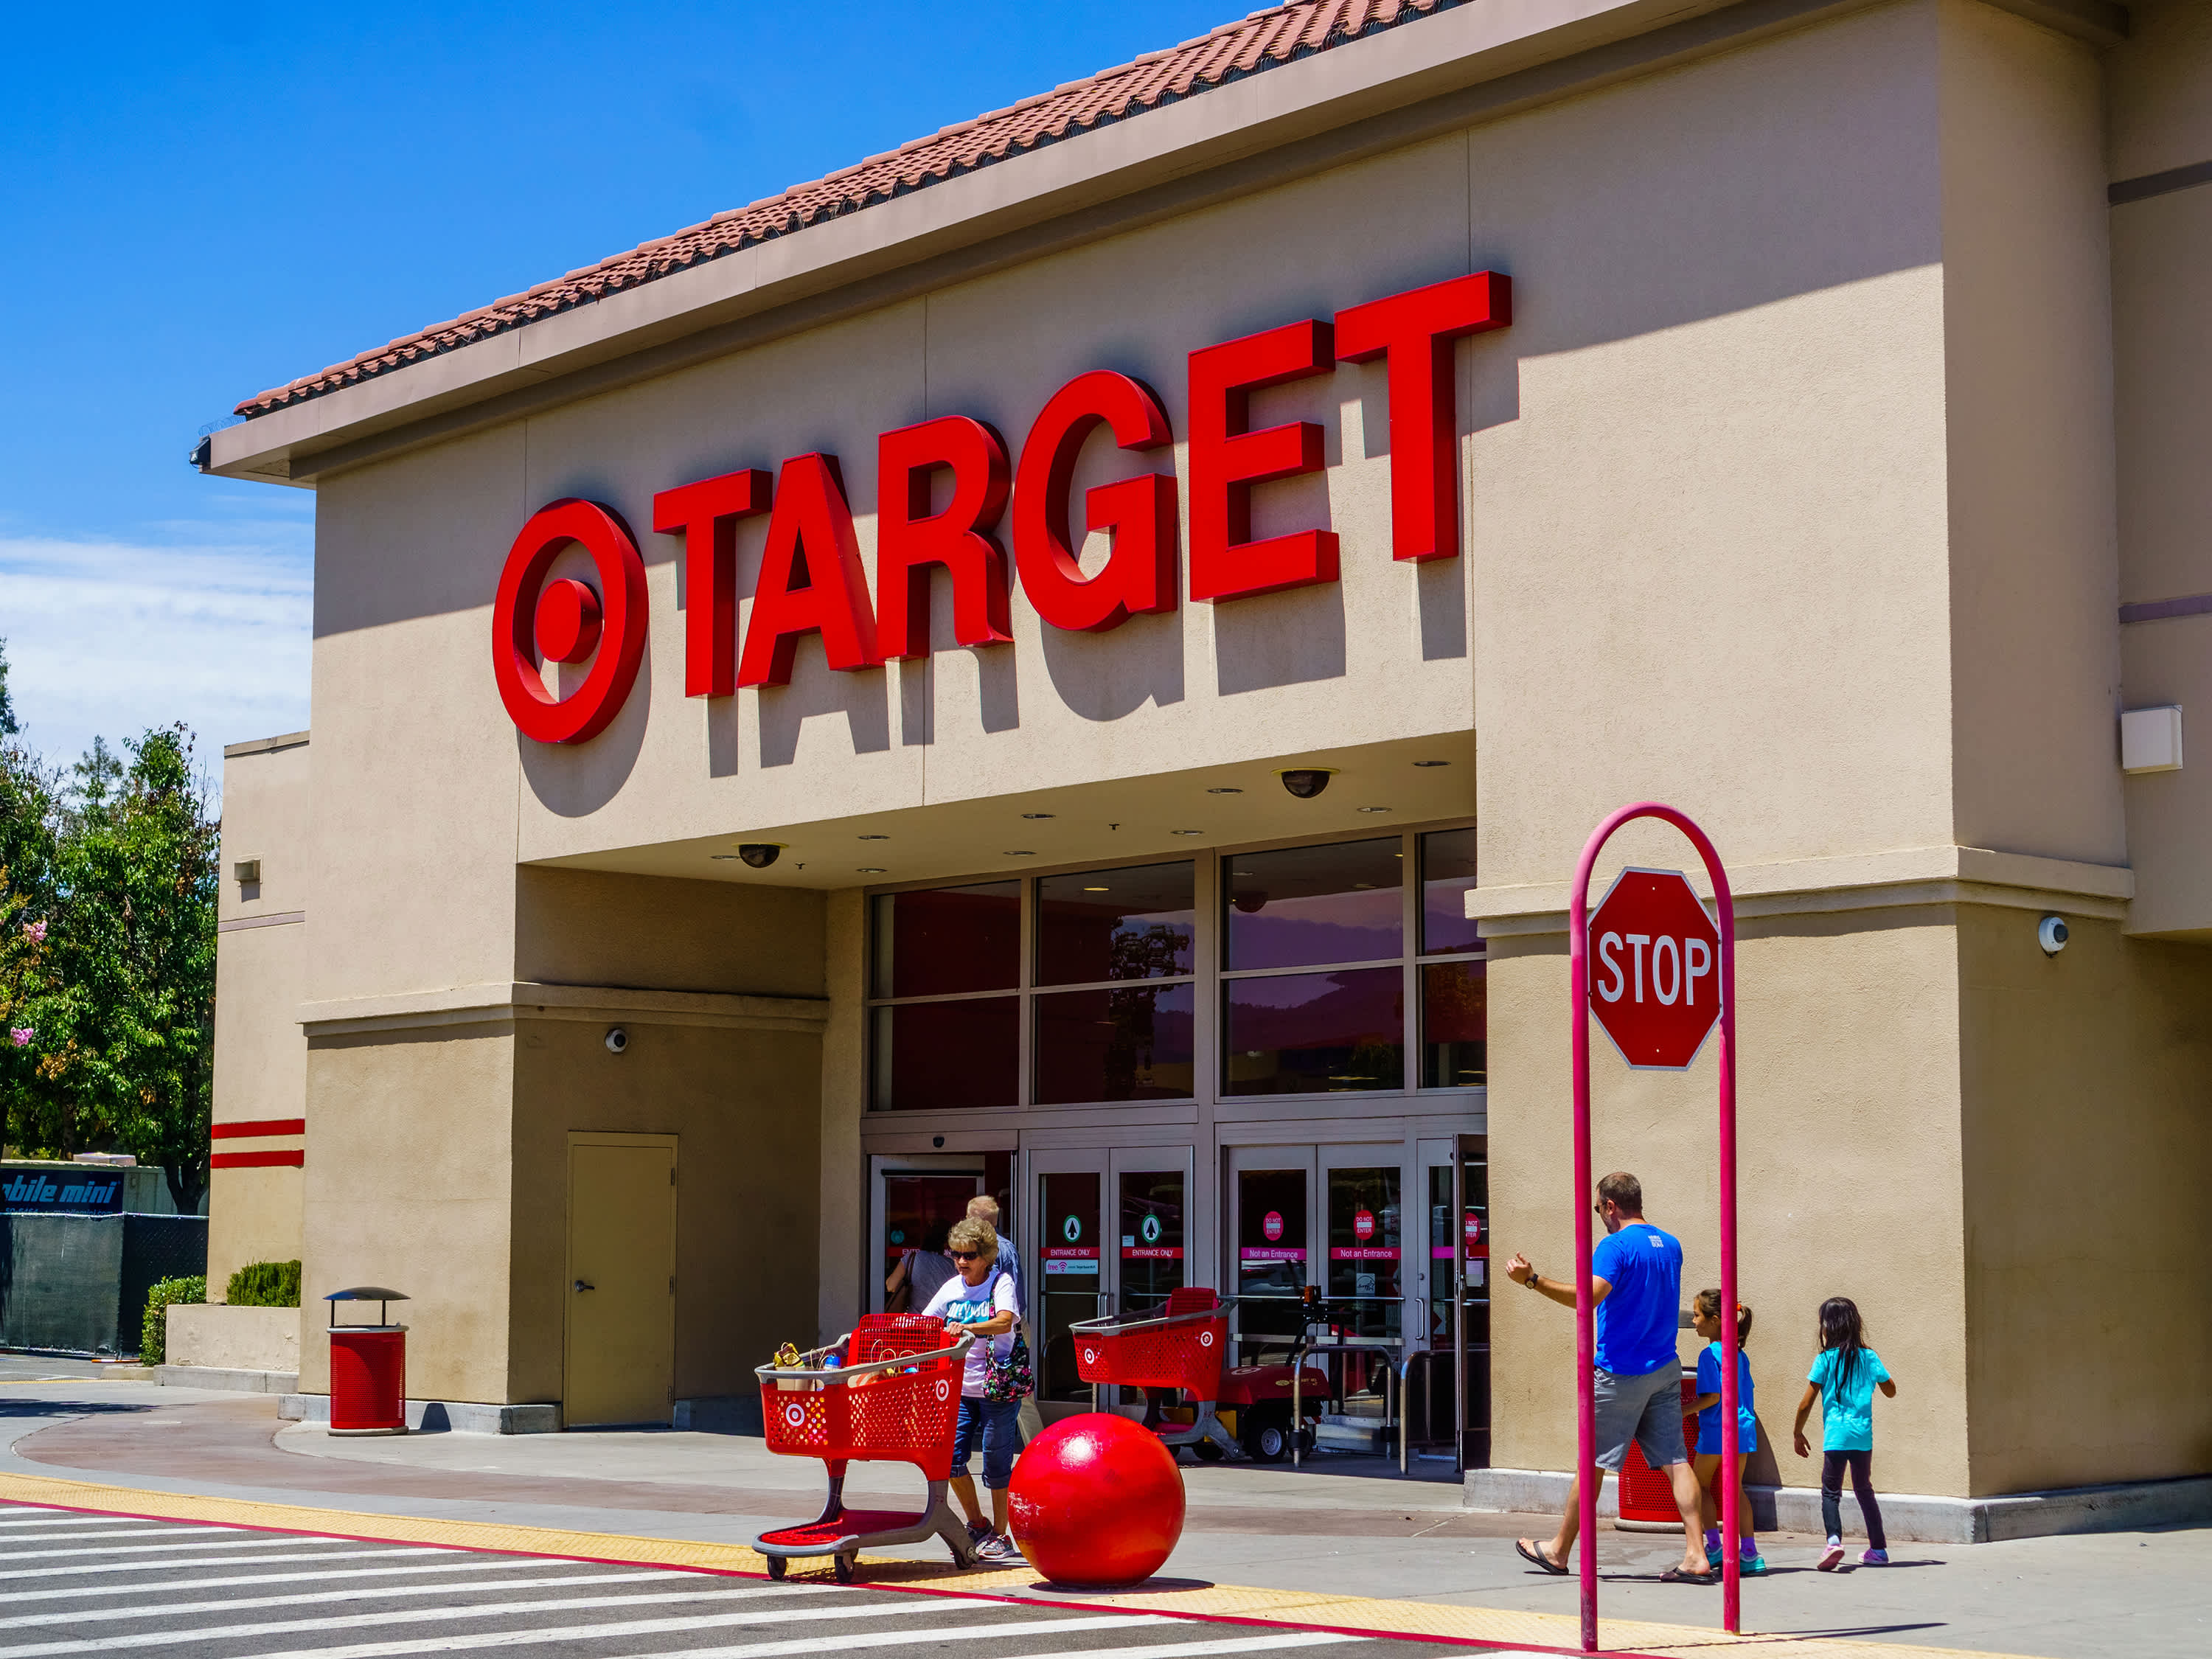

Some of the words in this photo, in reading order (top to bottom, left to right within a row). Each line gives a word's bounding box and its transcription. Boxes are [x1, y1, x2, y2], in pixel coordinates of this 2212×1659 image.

[653, 270, 1512, 699] TARGET
[1597, 931, 1711, 1006] STOP
[59, 1180, 117, 1203] mini
[1160, 1249, 1174, 1257] ONLY
[1270, 1250, 1298, 1258] Entrance
[1340, 1249, 1352, 1257] Not
[1363, 1249, 1393, 1258] Entrance
